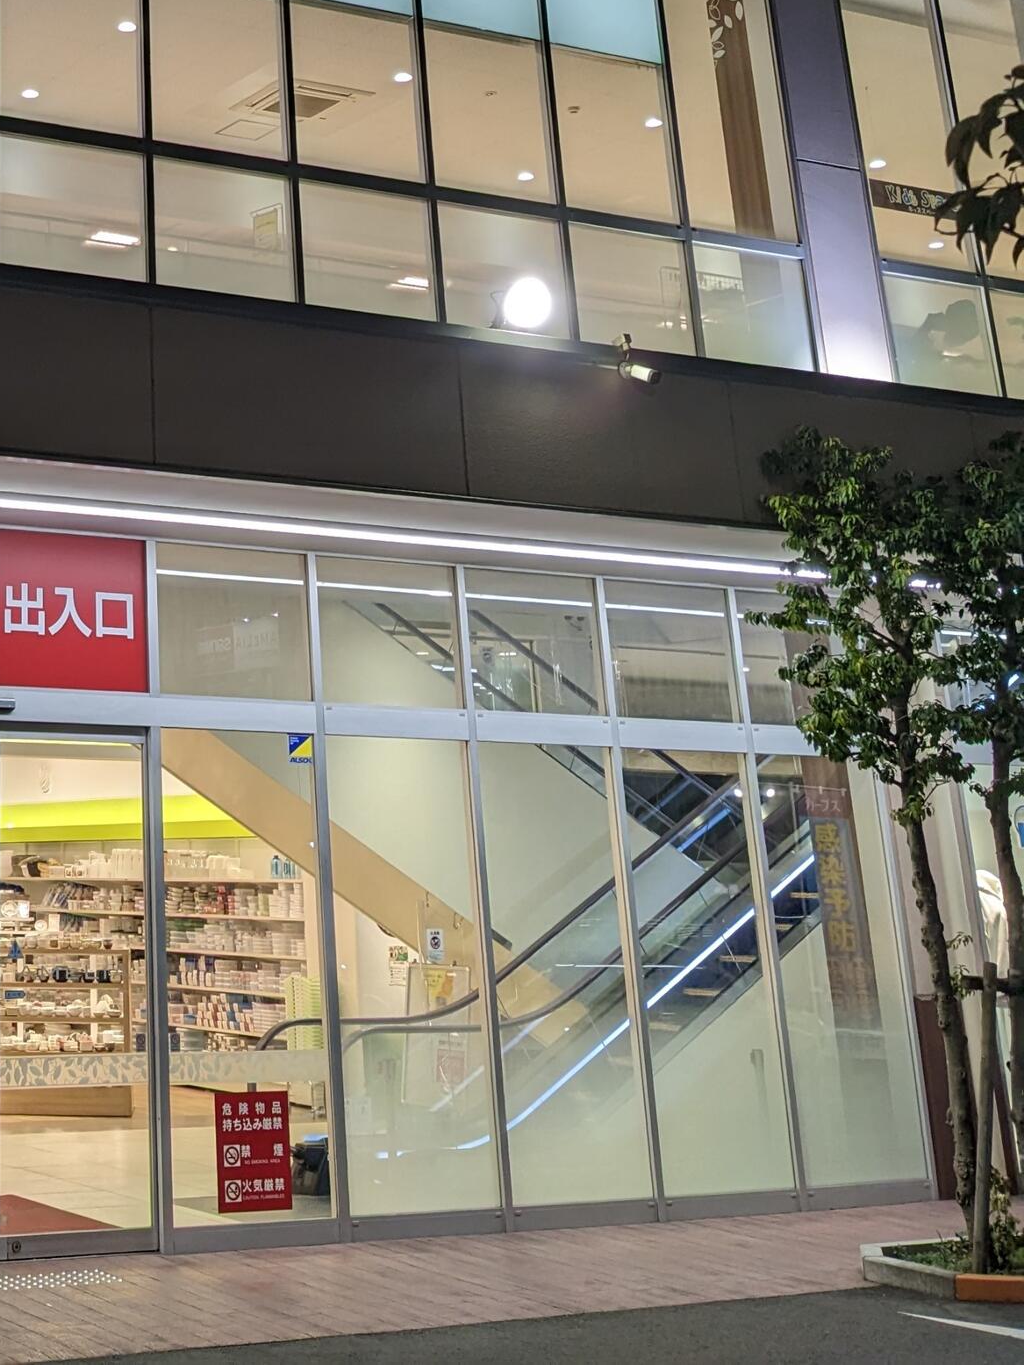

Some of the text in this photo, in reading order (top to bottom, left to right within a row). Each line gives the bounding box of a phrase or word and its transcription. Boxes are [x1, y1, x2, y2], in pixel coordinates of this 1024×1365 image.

[3, 582, 135, 640] 出入口
[222, 1101, 282, 1116] 危険物品
[222, 1117, 283, 1132] 持ち込み厳禁
[242, 1178, 285, 1192] 火気厳禁
